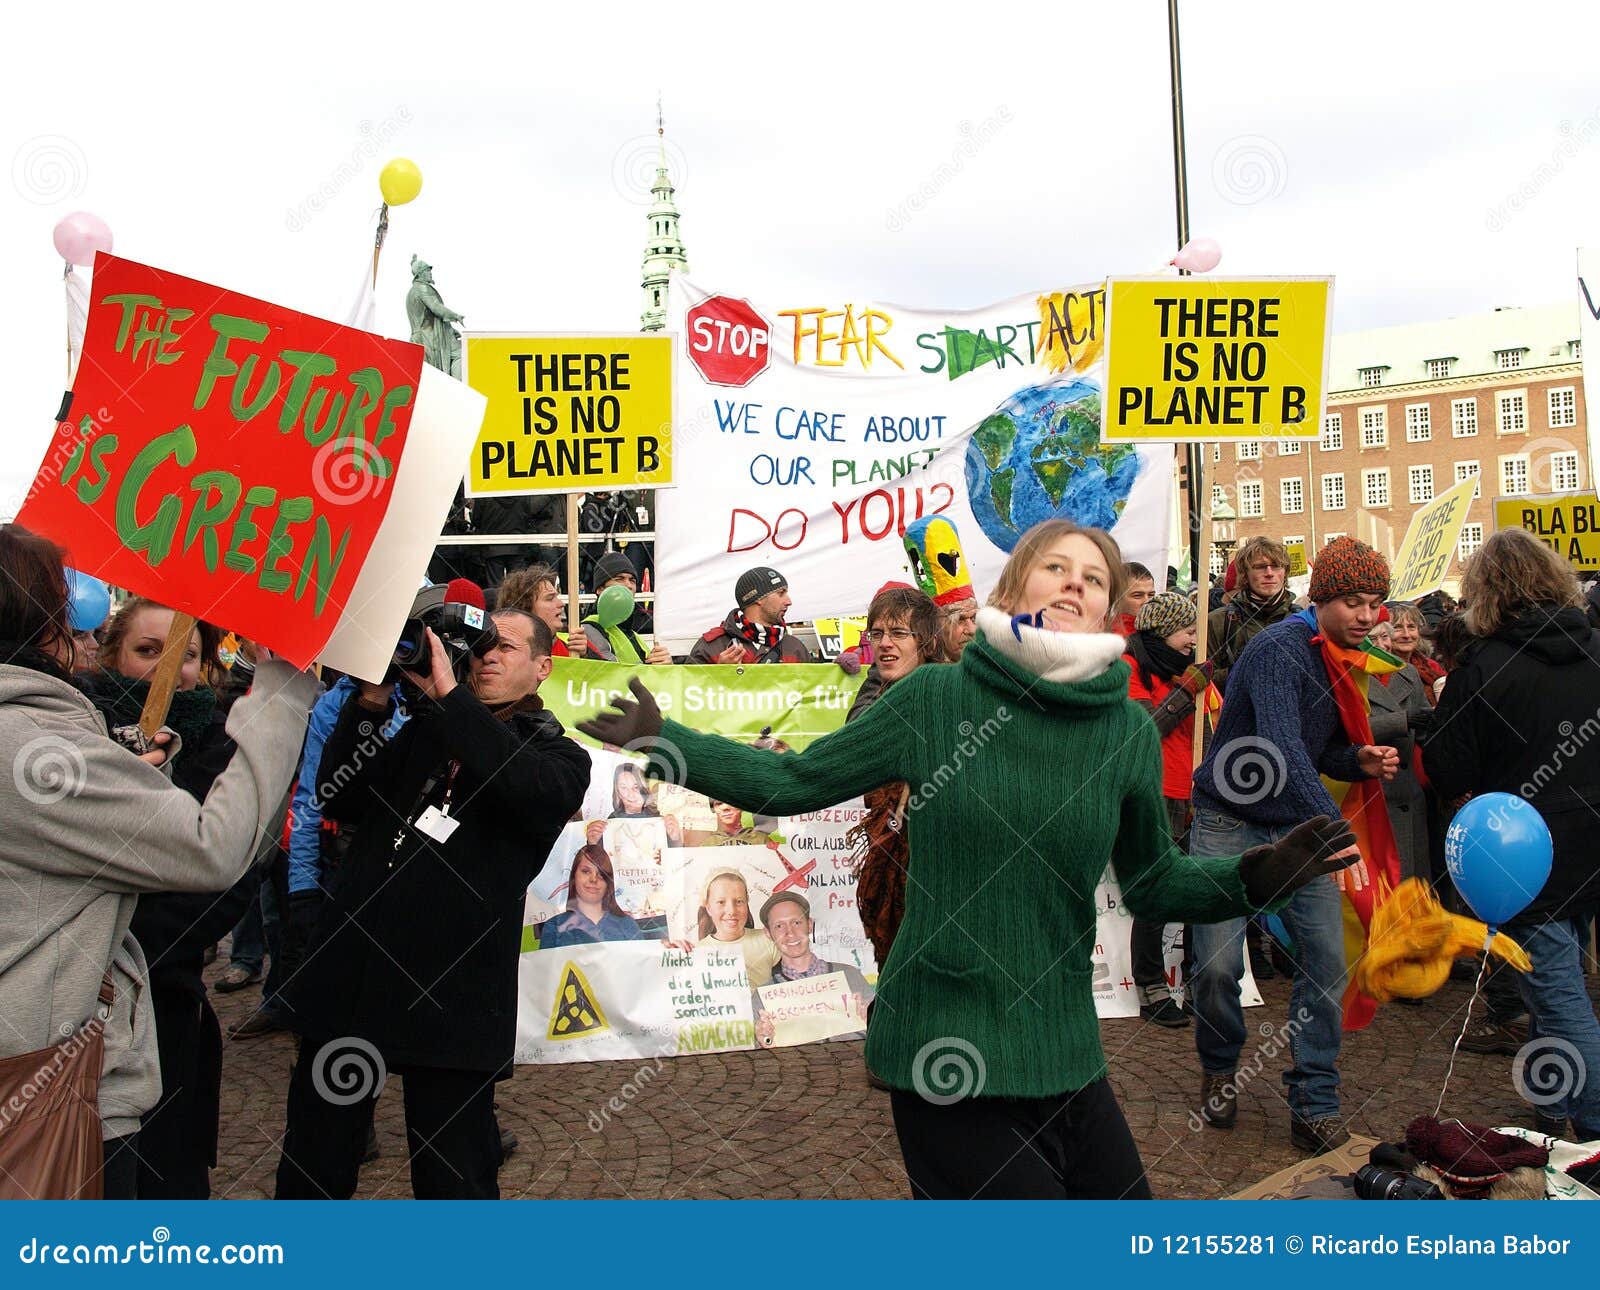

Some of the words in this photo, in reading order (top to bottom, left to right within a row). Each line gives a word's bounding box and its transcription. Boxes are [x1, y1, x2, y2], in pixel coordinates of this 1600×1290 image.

[1154, 298, 1280, 338] THERE
[693, 316, 767, 358] STOP
[777, 303, 905, 373] FEAR
[916, 321, 1042, 374] START
[510, 353, 631, 393] THERE
[1163, 342, 1199, 382] IS
[1213, 342, 1267, 382] NO
[101, 294, 195, 370] THE
[194, 314, 413, 478] FUTURE
[1118, 386, 1270, 426] PLANET
[1281, 386, 1306, 425] B
[523, 396, 559, 436] IS
[571, 395, 621, 434] NO
[714, 399, 763, 434] WE
[775, 407, 846, 442] CARE
[863, 416, 947, 442] ABOUT
[481, 437, 625, 480] PLANET
[637, 436, 660, 473] B
[750, 454, 816, 485] OUR
[832, 447, 941, 487] PLANET
[61, 414, 119, 505] IS
[115, 424, 353, 618] GREEN
[727, 508, 808, 553] DO
[1416, 496, 1460, 541] THERE
[1522, 507, 1566, 535] BLA
[1404, 541, 1423, 570] IS
[1418, 529, 1443, 561] NO
[1430, 554, 1447, 582] B
[567, 679, 673, 711] Unse
[684, 685, 801, 712] Stimme
[814, 684, 853, 711] für
[661, 952, 694, 968] Nicht
[707, 951, 739, 968] über
[668, 976, 693, 990] die
[701, 971, 751, 990] Umwelt
[674, 1003, 737, 1020] sondern
